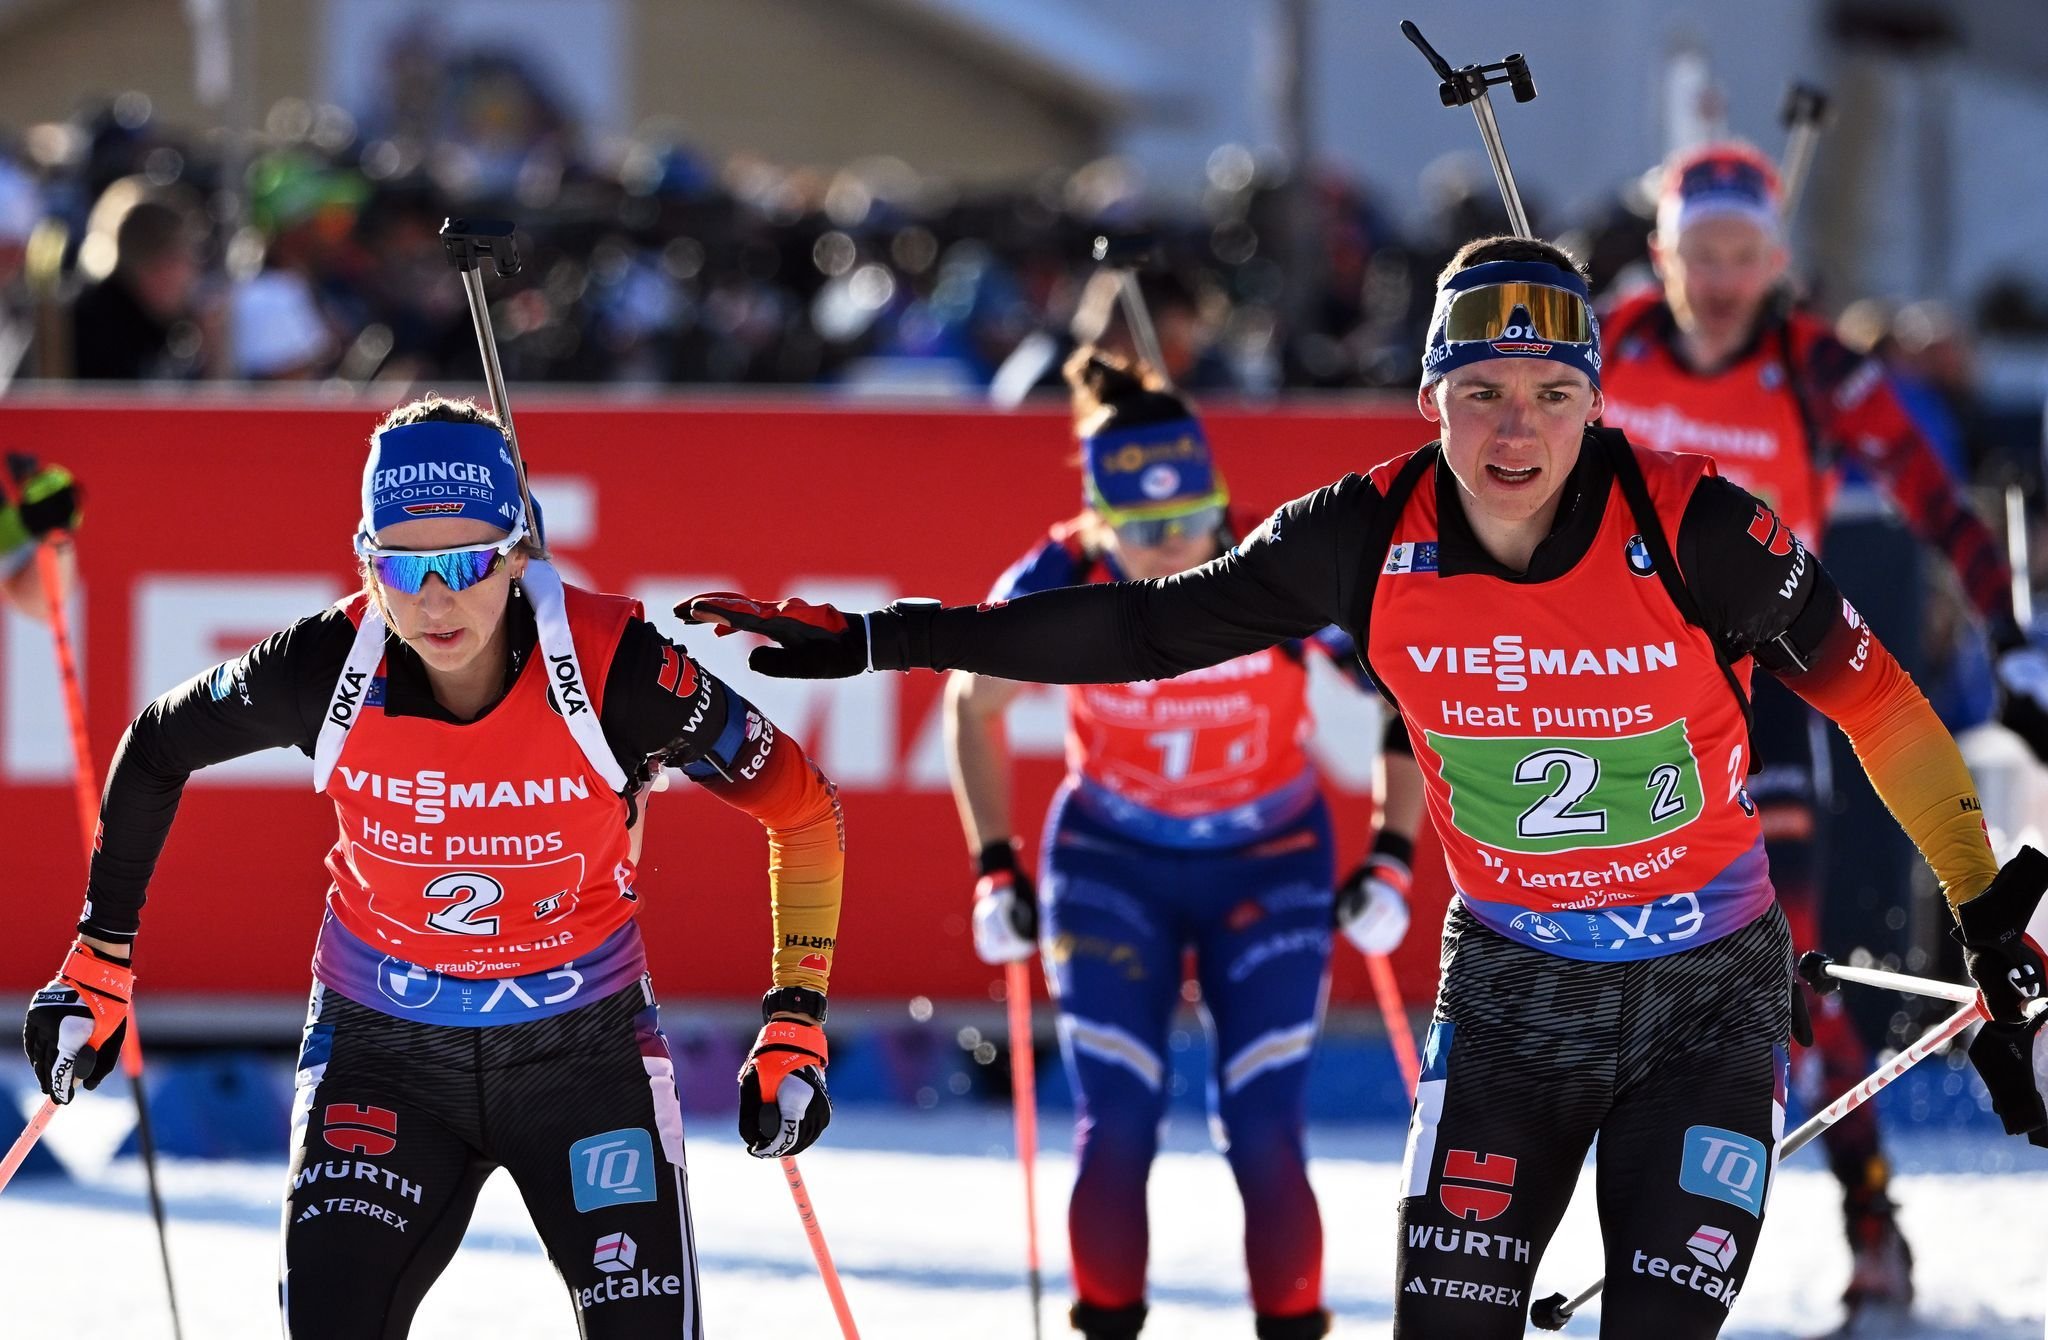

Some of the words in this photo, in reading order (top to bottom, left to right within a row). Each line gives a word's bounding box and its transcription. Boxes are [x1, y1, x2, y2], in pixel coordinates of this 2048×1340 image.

[1423, 343, 1453, 370] ERREX
[373, 484, 494, 507] ALKOHOLFREI
[374, 461, 494, 494] ERDINGER
[550, 654, 587, 716] JOKA
[1406, 635, 1678, 692] VIESSMANN
[329, 667, 366, 730] JOKA
[1441, 700, 1521, 728] Heat
[1532, 704, 1654, 733] pumps
[740, 718, 775, 780] tecta
[1146, 727, 1196, 783] 1
[337, 766, 591, 825] VIESSMANN
[1513, 747, 1608, 839] 2
[1646, 763, 1687, 825] 2
[362, 816, 433, 855] Heat
[445, 831, 563, 860] pumps
[1517, 845, 1687, 889] Lenzerheide
[423, 871, 504, 936] 2
[462, 988, 473, 1012] THE
[293, 1160, 423, 1204] WÜRTH
[582, 1140, 642, 1194] TQ
[1700, 1136, 1759, 1204] TQ
[324, 1198, 409, 1232] TERREX
[1409, 1224, 1531, 1264] WÜRTH
[575, 1268, 680, 1312] tectake
[1431, 1277, 1522, 1308] TERREX
